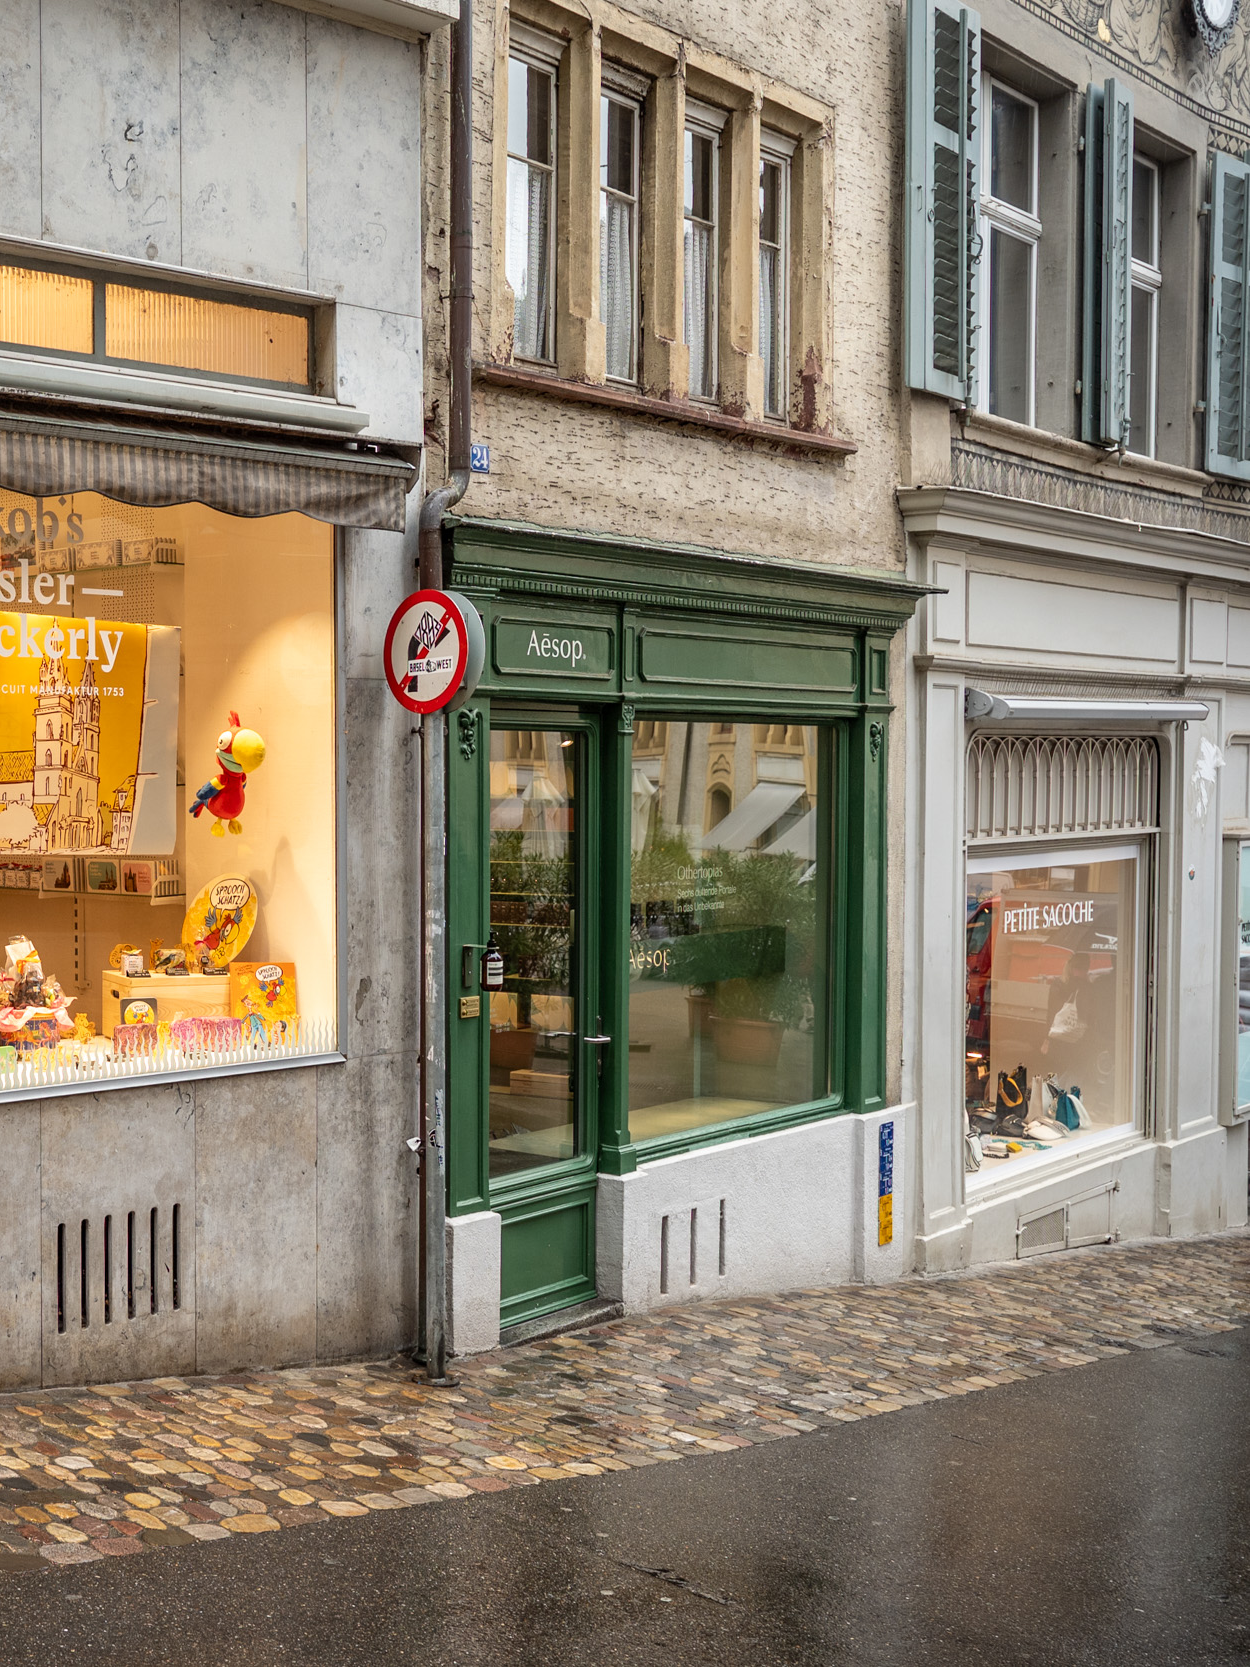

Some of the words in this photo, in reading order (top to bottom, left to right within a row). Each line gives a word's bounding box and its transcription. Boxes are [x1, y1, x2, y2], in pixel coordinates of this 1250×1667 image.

[472, 446, 488, 469] 24
[409, 661, 425, 673] BASEL
[436, 658, 452, 670] WEST
[30, 684, 99, 697] MANUFAKTUR
[103, 686, 125, 697] 1753
[677, 865, 723, 882] Othertopias
[216, 884, 246, 896] SPROOCH
[677, 888, 694, 899] Sechs
[718, 885, 737, 895] Portale
[217, 895, 244, 905] SCHATZ!
[677, 903, 682, 912] in
[682, 903, 693, 912] das
[1042, 900, 1094, 929] SACOCHE
